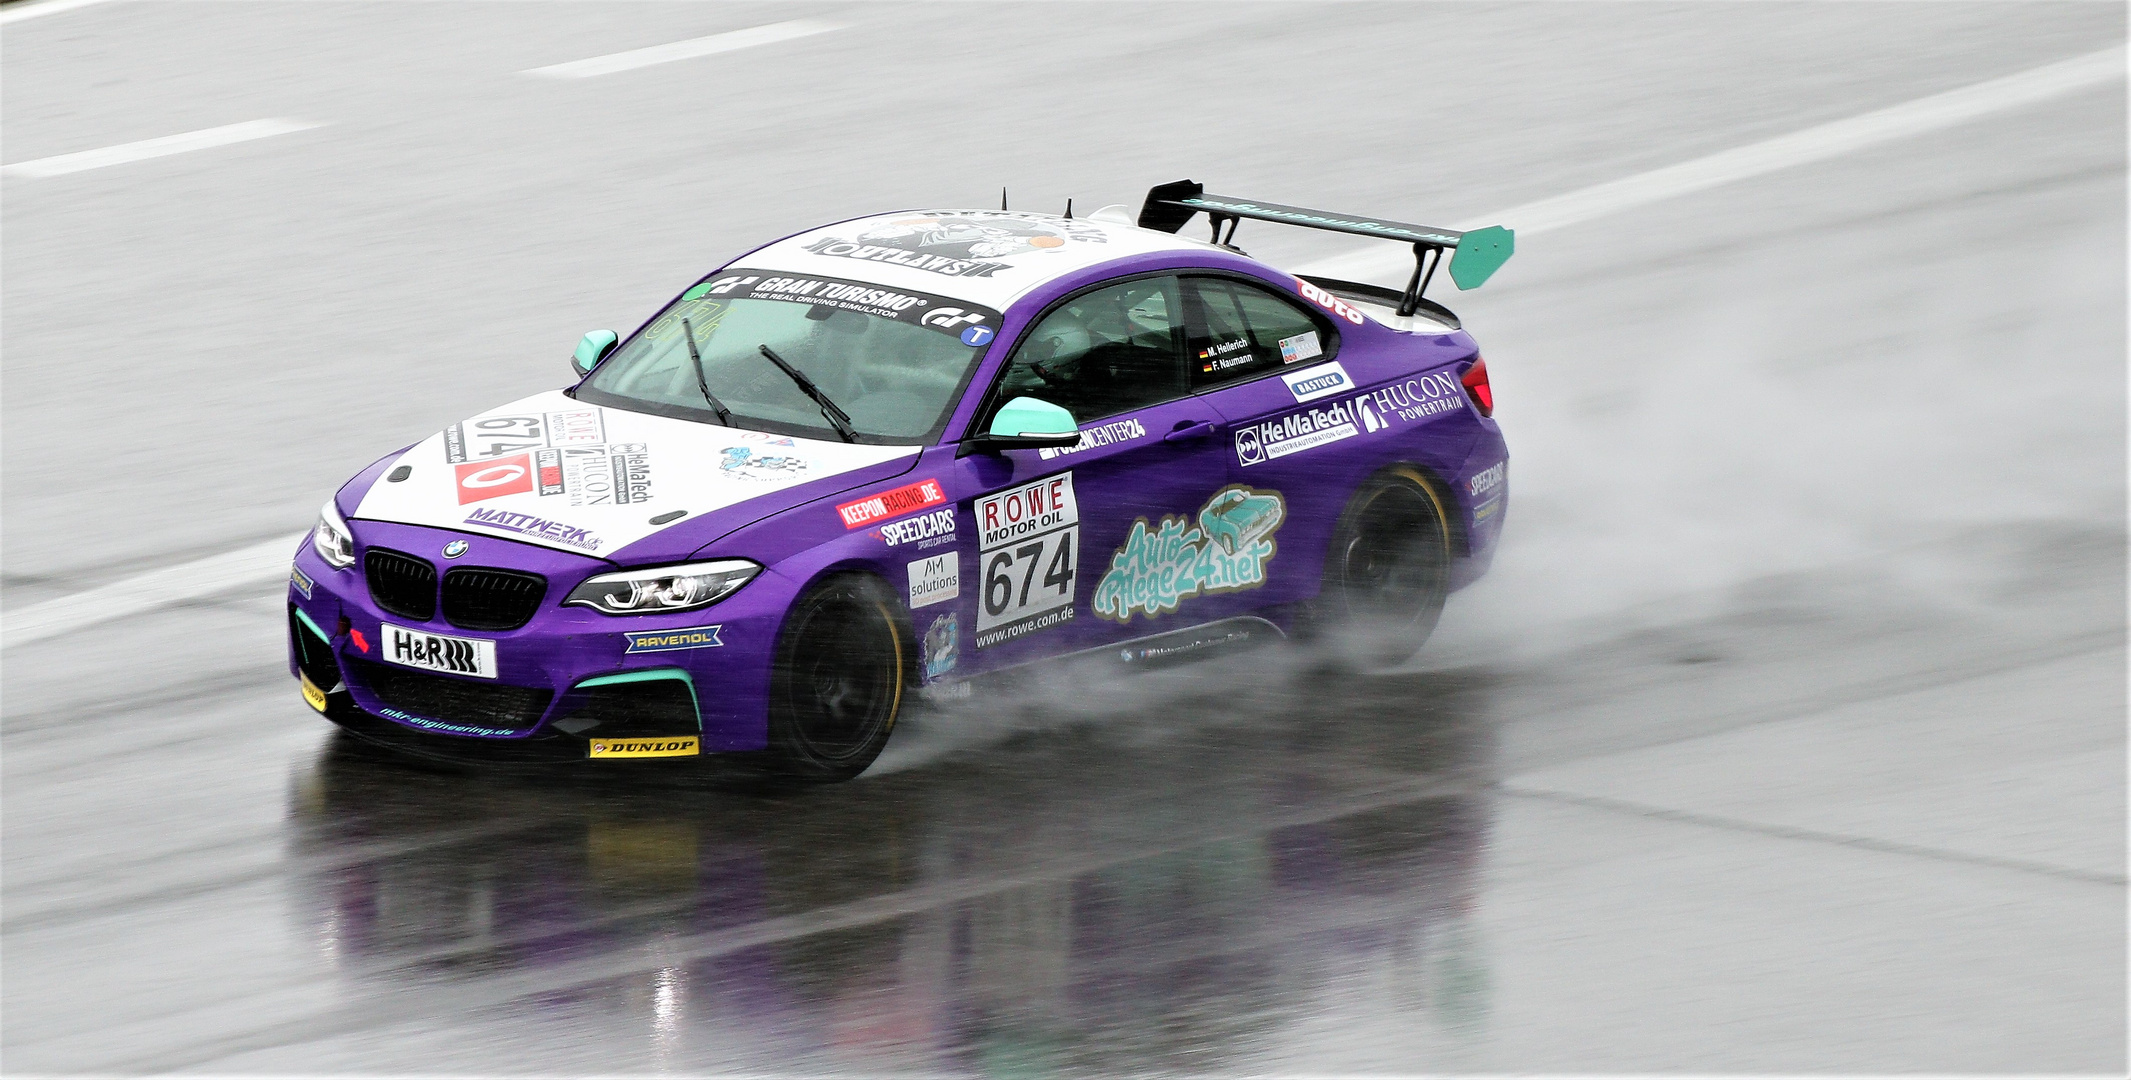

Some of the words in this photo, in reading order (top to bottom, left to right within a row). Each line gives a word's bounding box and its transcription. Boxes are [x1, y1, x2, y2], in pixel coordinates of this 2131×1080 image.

[822, 241, 971, 276] OUTLAWS
[754, 277, 816, 296] GRAN
[749, 292, 768, 300] THE
[769, 293, 793, 302] REAL
[796, 296, 838, 308] DRIVING
[838, 302, 898, 318] SIMULATOR
[1301, 283, 1365, 325] auto
[969, 327, 990, 343] T
[1207, 347, 1217, 358] M.
[1217, 337, 1248, 354] Hellerich
[1212, 361, 1220, 371] F.
[1220, 353, 1253, 369] Naumann
[1296, 374, 1340, 394] BASTUCK
[1372, 371, 1458, 413] HUCON
[1260, 402, 1350, 444] HeMaTech
[1398, 396, 1463, 421] POWERTRAIN
[475, 416, 542, 456] 674
[566, 412, 595, 441] ROWE
[1268, 431, 1336, 455] INDUSTRIEAUTOMATION
[1336, 426, 1354, 436] GmbH
[583, 457, 610, 505] HUCON
[628, 453, 654, 503] HeMaTech
[841, 483, 941, 525] KEEPONRACING.DE
[984, 479, 1064, 530] ROWE
[467, 507, 593, 542] MATTWERK
[880, 509, 955, 546] SPEEDCARS
[985, 519, 1037, 545] MOTOR
[1041, 511, 1063, 527] OIL
[911, 575, 957, 597] solutions
[984, 532, 1074, 616] 674
[636, 633, 712, 648] RAVENOL
[976, 606, 1074, 648] www.rowe.com.de
[380, 708, 515, 736] mkr-engineering.de
[609, 741, 695, 753] DUNLOP
